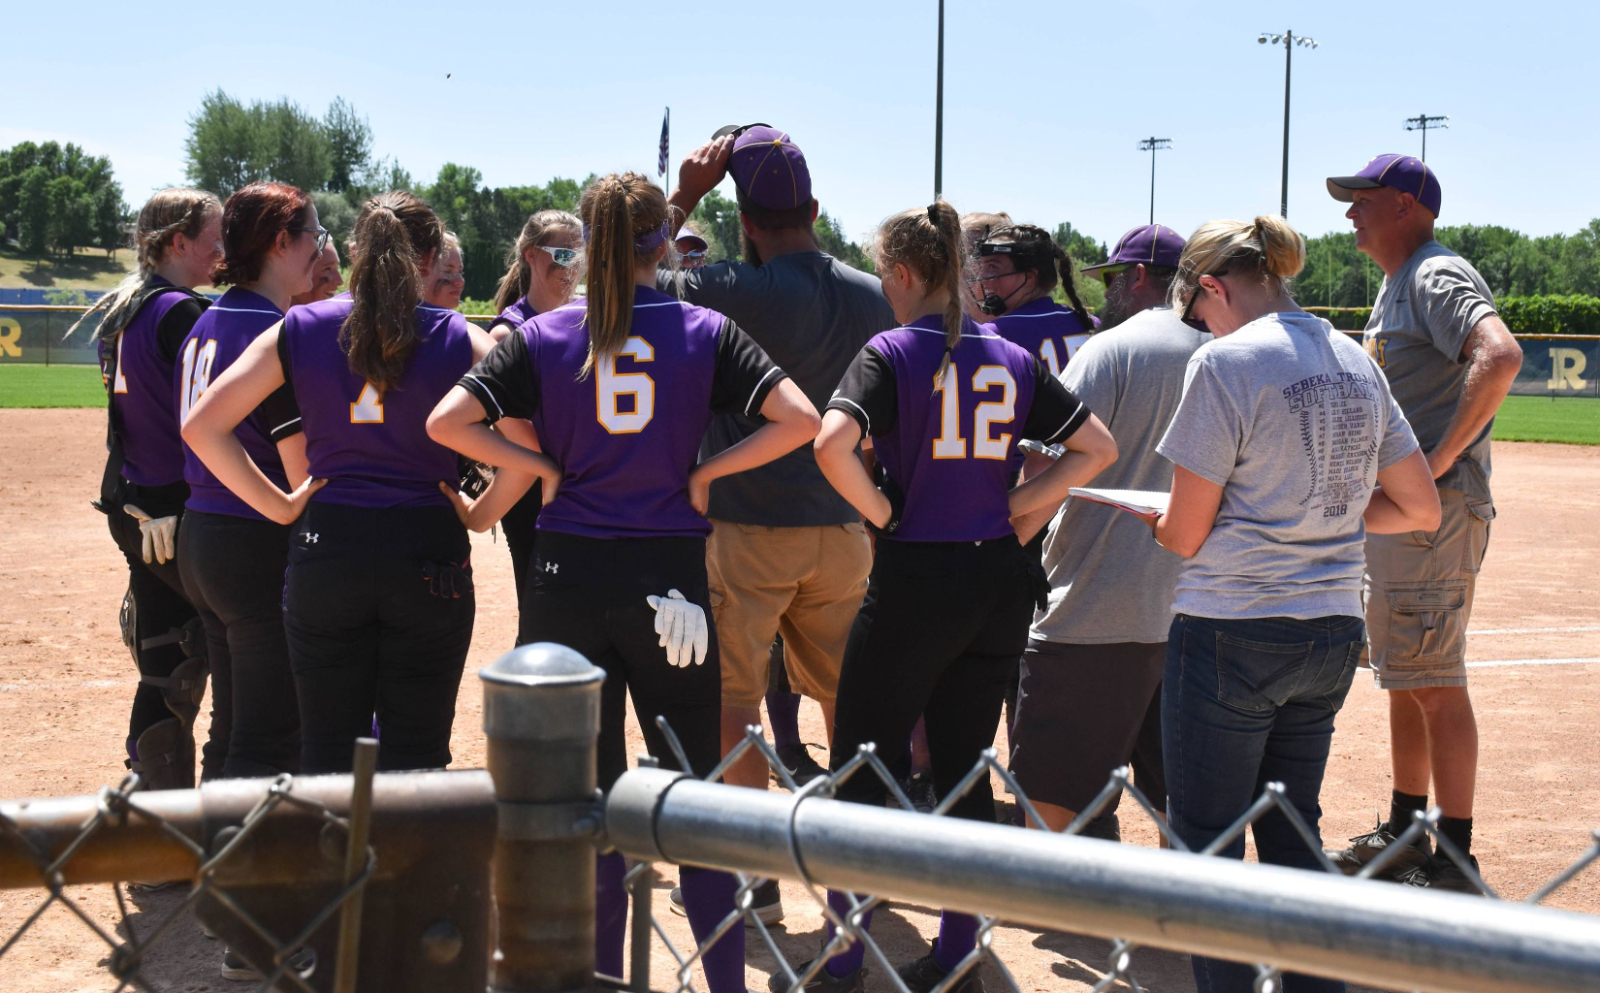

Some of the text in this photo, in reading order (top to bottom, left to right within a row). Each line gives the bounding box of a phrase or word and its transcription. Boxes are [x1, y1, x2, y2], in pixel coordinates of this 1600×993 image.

[595, 335, 655, 434] 6
[1283, 373, 1332, 399] SEBEKA
[1547, 347, 1587, 390] R
[932, 362, 1018, 461] 12
[1289, 382, 1377, 414] SOFTBAL
[1323, 504, 1347, 517] 2018
